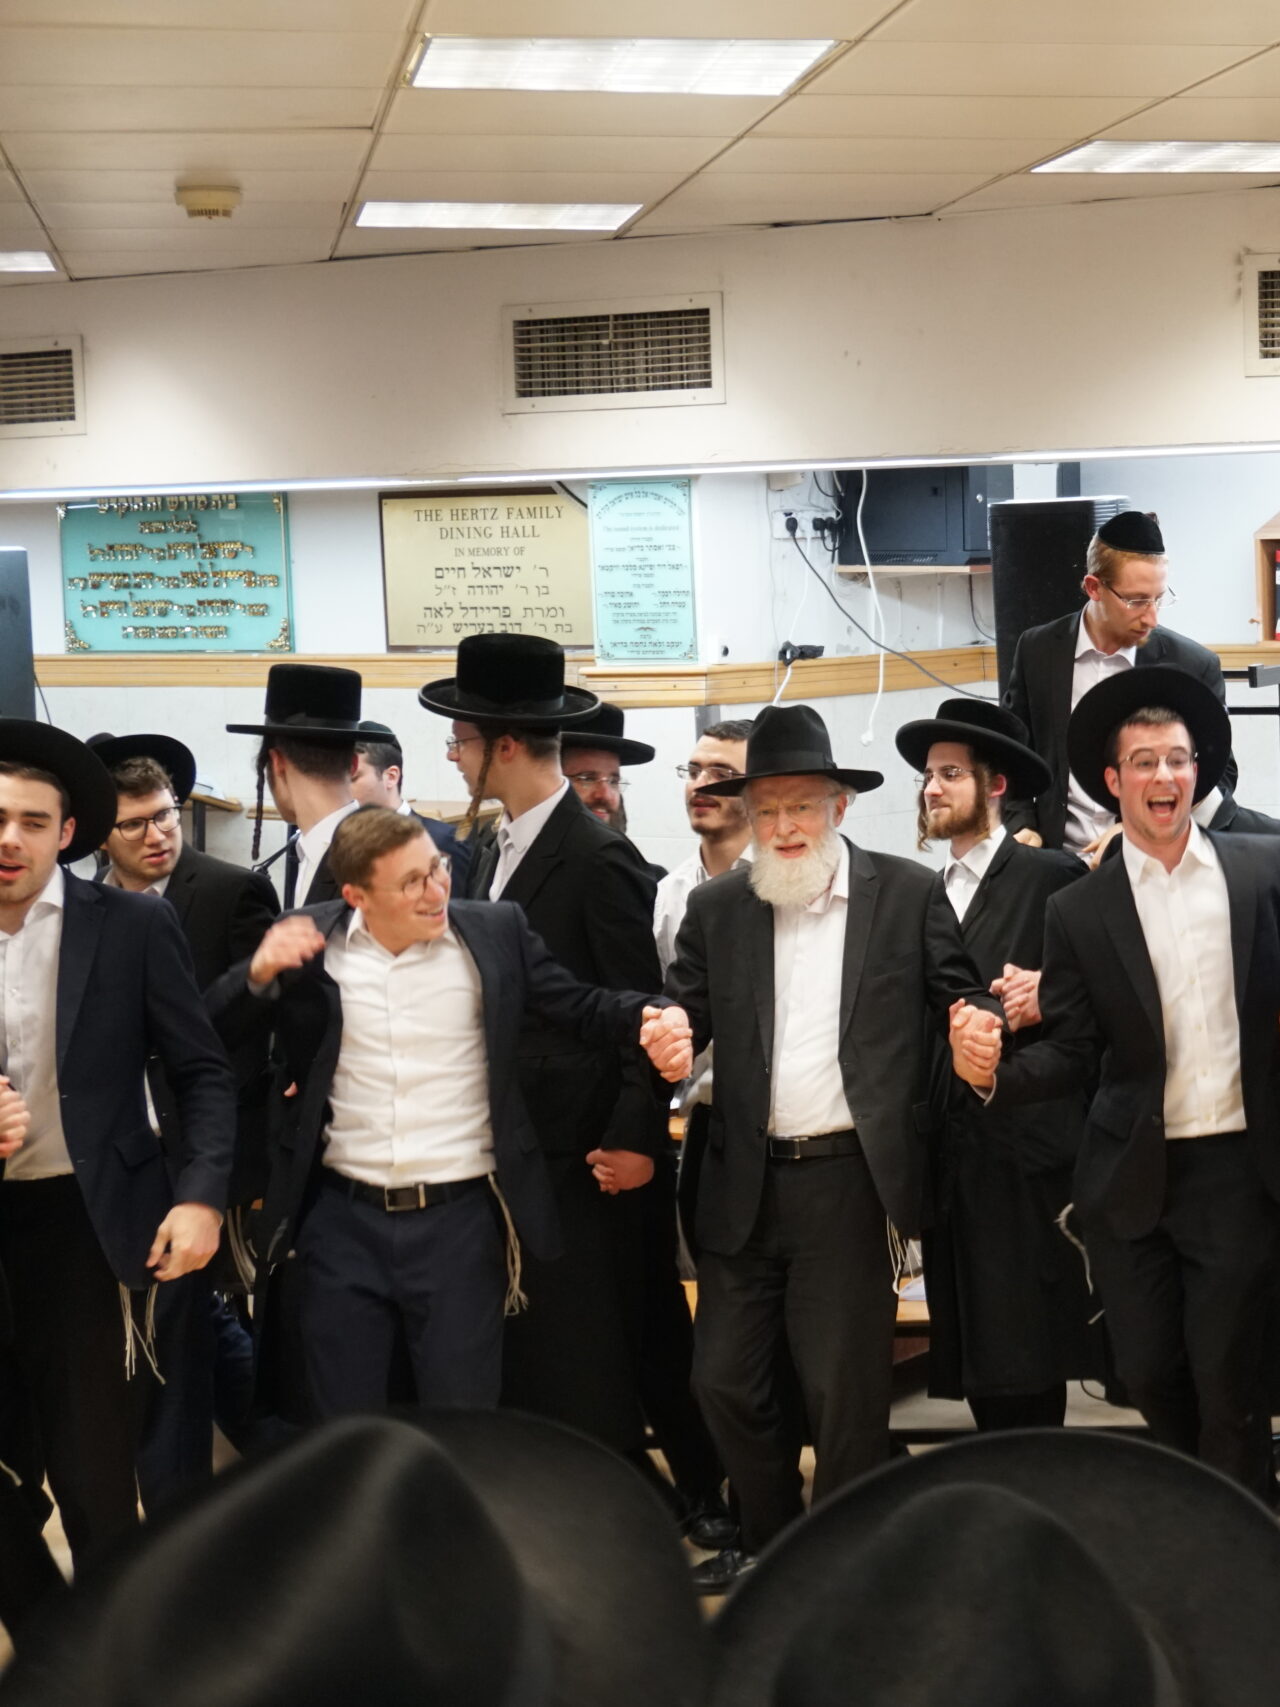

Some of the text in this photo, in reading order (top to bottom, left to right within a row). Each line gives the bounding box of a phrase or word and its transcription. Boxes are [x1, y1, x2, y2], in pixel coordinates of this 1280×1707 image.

[414, 506, 564, 522] THE HERTZ FAMILY
[439, 525, 541, 540] DINING HALL
[455, 546, 525, 557] IN MEMORY OF
[434, 566, 466, 579] חיים
[471, 562, 521, 579] ישראל
[467, 585, 504, 596] יהודה
[536, 585, 550, 597] בן
[423, 602, 565, 619] ומרת פריידל לאה
[453, 623, 495, 635] בעריש
[500, 622, 523, 634] דוב
[554, 622, 574, 633] בת
